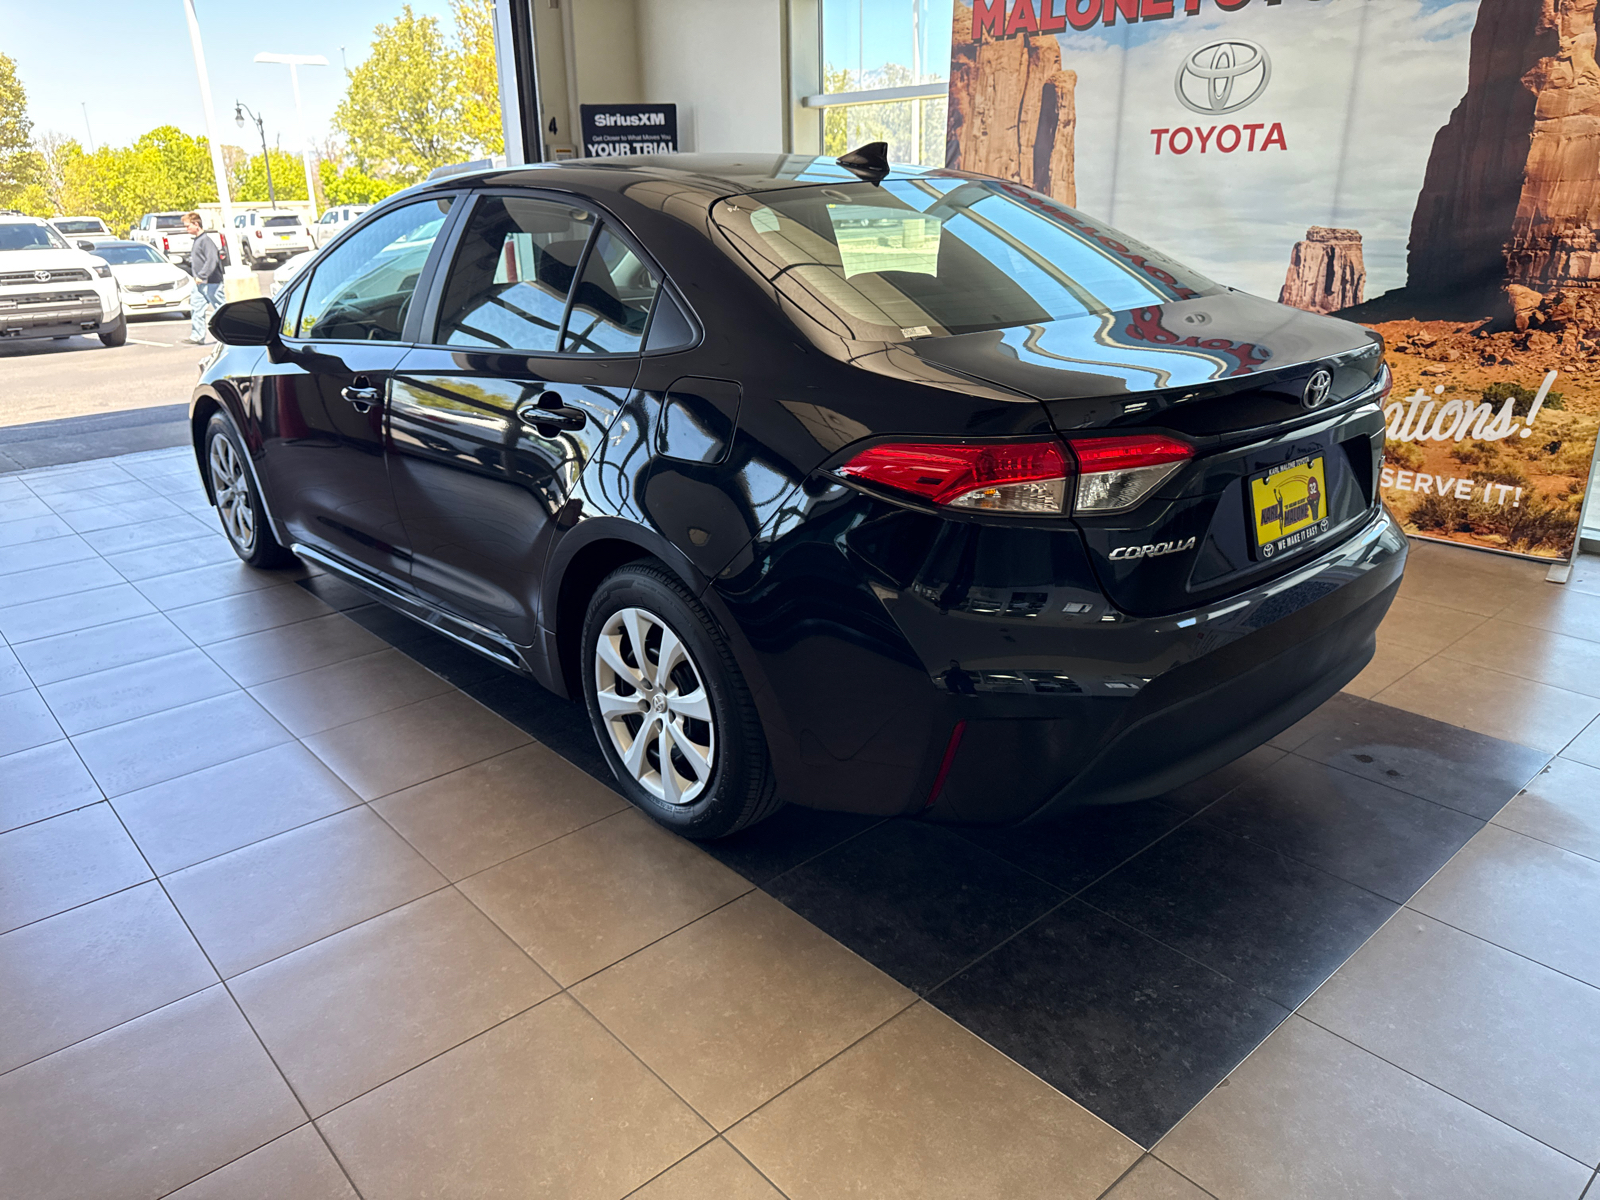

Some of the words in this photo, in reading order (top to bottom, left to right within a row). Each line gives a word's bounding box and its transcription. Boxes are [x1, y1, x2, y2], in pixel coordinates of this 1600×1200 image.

[548, 116, 558, 136] 4
[594, 112, 665, 127] SiriusXM
[587, 142, 631, 157] YOUR
[633, 141, 678, 156] TRIAL
[1150, 122, 1287, 155] TOYOTA
[1309, 482, 1317, 494] 32
[1381, 468, 1475, 500] SERVE
[1483, 482, 1523, 508] IT!
[1108, 536, 1196, 561] COROLLA
[1277, 539, 1287, 551] WE
[1287, 533, 1300, 547] MAKE
[1300, 530, 1306, 541] IT
[1306, 525, 1318, 539] EASY
